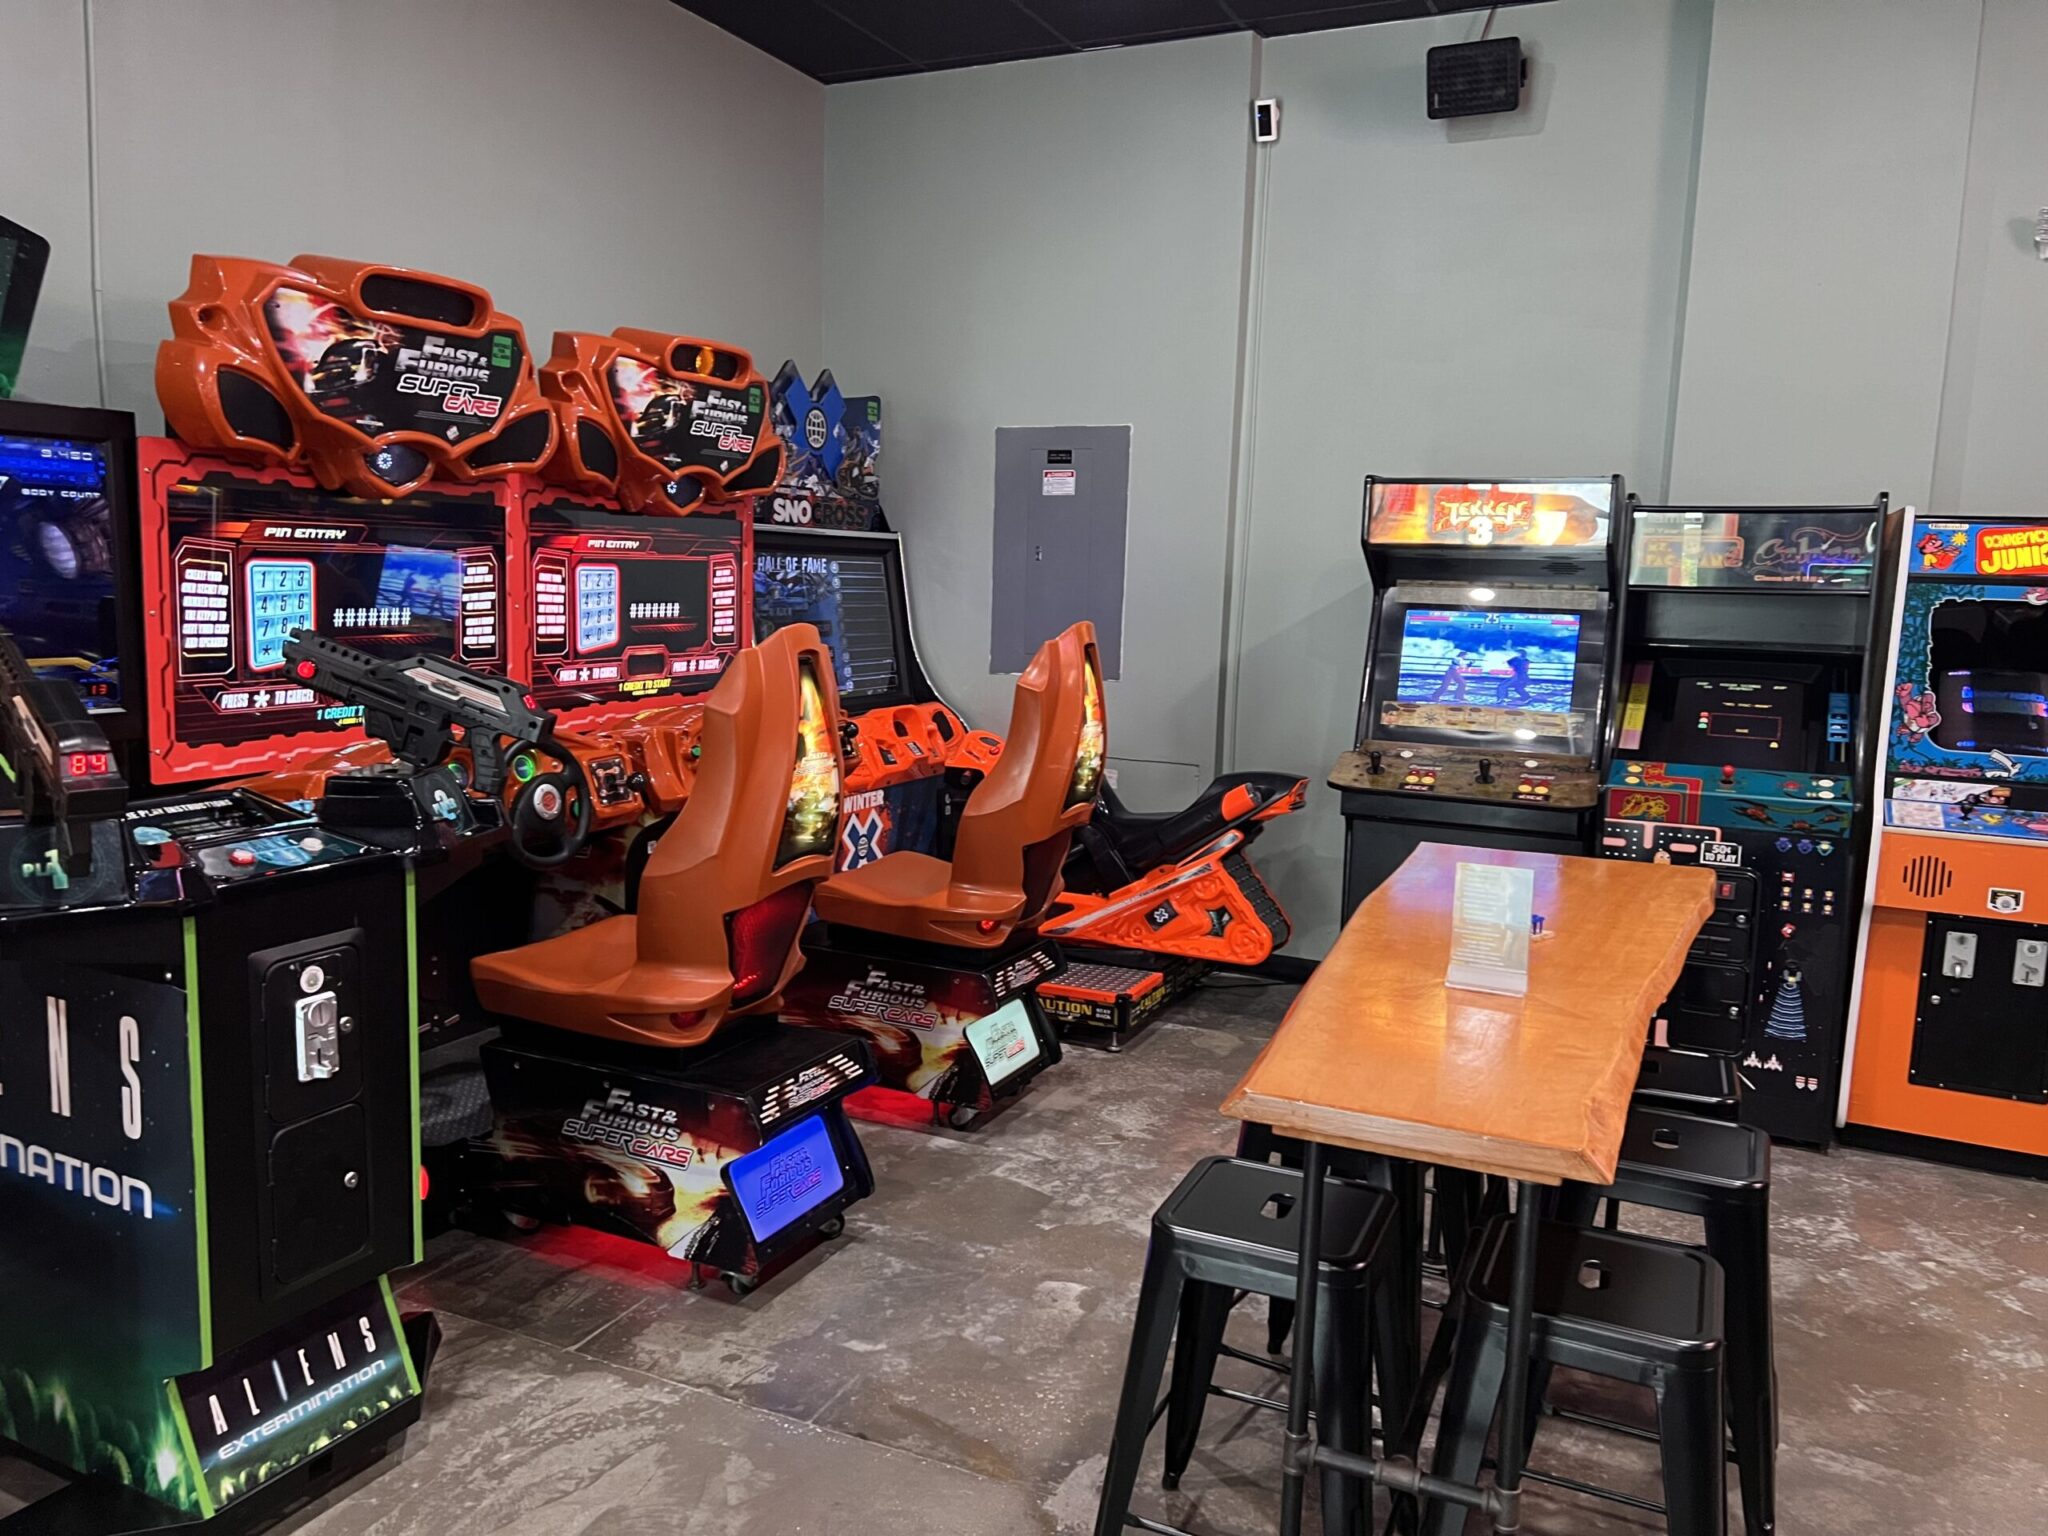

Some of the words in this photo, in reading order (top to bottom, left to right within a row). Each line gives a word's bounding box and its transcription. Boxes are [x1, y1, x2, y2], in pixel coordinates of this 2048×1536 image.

[422, 335, 478, 365] FAST
[395, 347, 490, 383] FURIOUS
[396, 373, 481, 399] SUPER
[442, 394, 502, 417] CARS
[690, 400, 749, 425] FURIOUS
[706, 389, 743, 411] FAST
[690, 420, 743, 438] SUPER
[60, 490, 101, 499] COUNT
[1440, 500, 1531, 529] TEKKEN
[264, 526, 292, 538] PIN
[294, 527, 347, 540] ENTRY
[1467, 515, 1494, 546] 3
[785, 556, 798, 573] OF
[801, 557, 827, 574] FAME
[261, 571, 267, 588] 1
[279, 570, 288, 588] 2
[297, 570, 305, 587] 3
[261, 596, 268, 613] 4
[280, 594, 288, 612] 5
[298, 593, 305, 610] 6
[262, 620, 270, 637] 7
[281, 617, 288, 634] 8
[324, 706, 355, 720] CREDIT
[843, 789, 885, 814] WINTER
[1704, 852, 1716, 861] TO
[1716, 854, 1737, 863] PLAY
[866, 969, 914, 994] FAST
[844, 980, 928, 1009] FURIOUS
[604, 1088, 667, 1122] FAST
[580, 1099, 682, 1144] FURIOUS
[208, 1316, 377, 1436] ALIENS
[217, 1358, 387, 1460] EXTERMINATION
